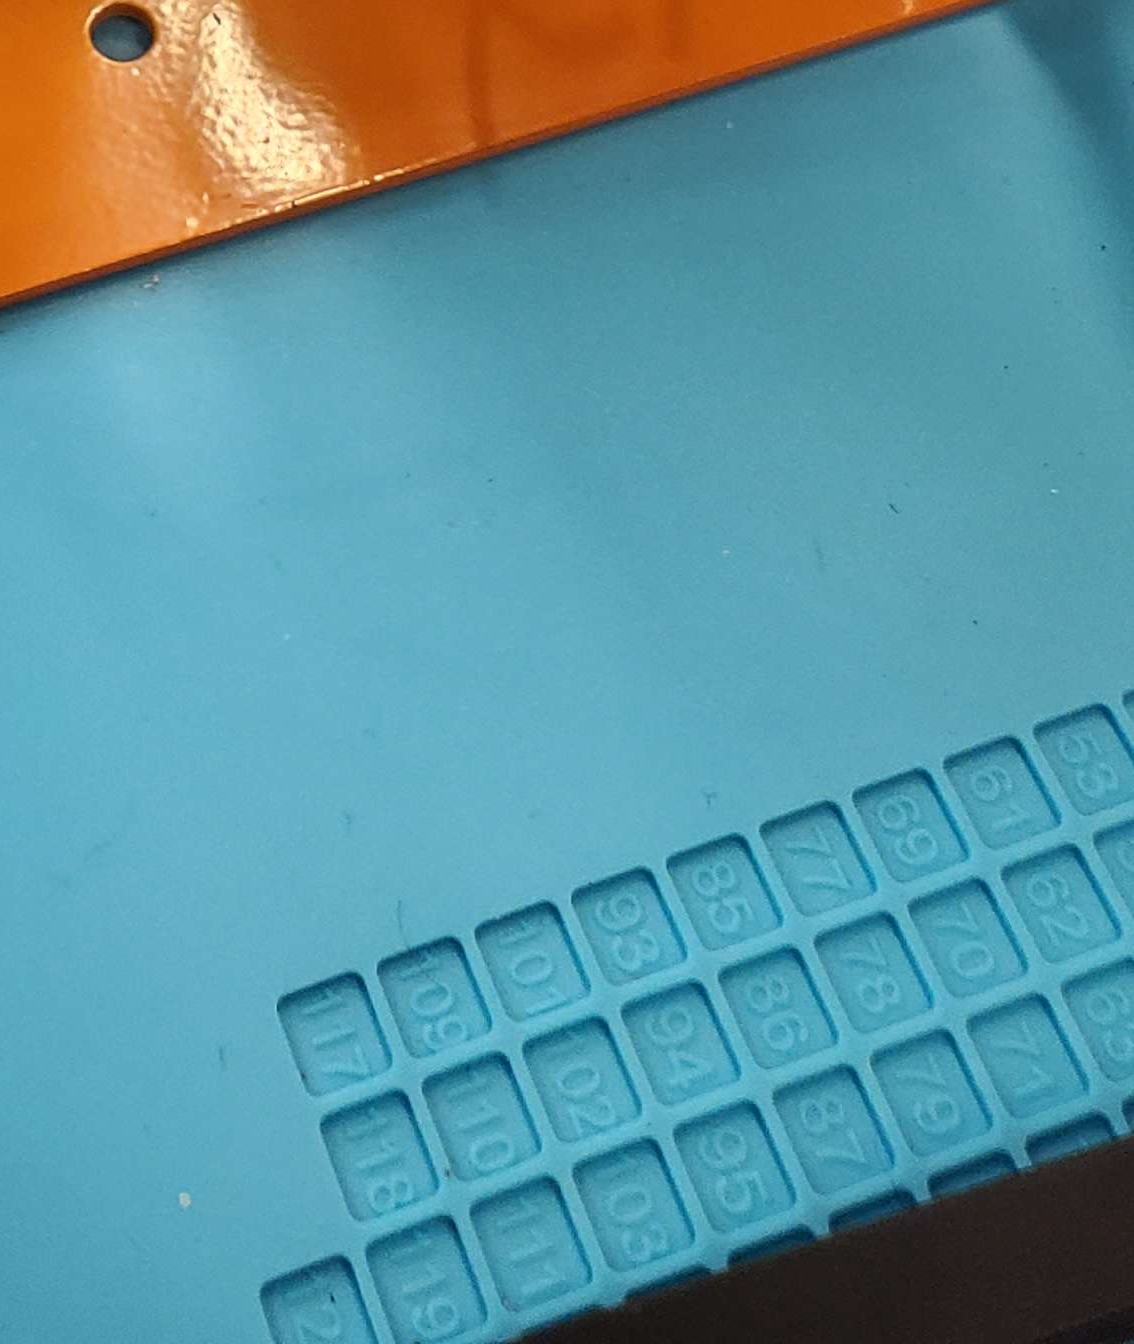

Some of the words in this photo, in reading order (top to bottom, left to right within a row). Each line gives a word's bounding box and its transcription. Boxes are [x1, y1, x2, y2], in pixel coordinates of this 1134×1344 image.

[971, 765, 1030, 831] 61
[785, 826, 854, 891] 77
[692, 862, 754, 934] 85
[595, 894, 660, 972] 93
